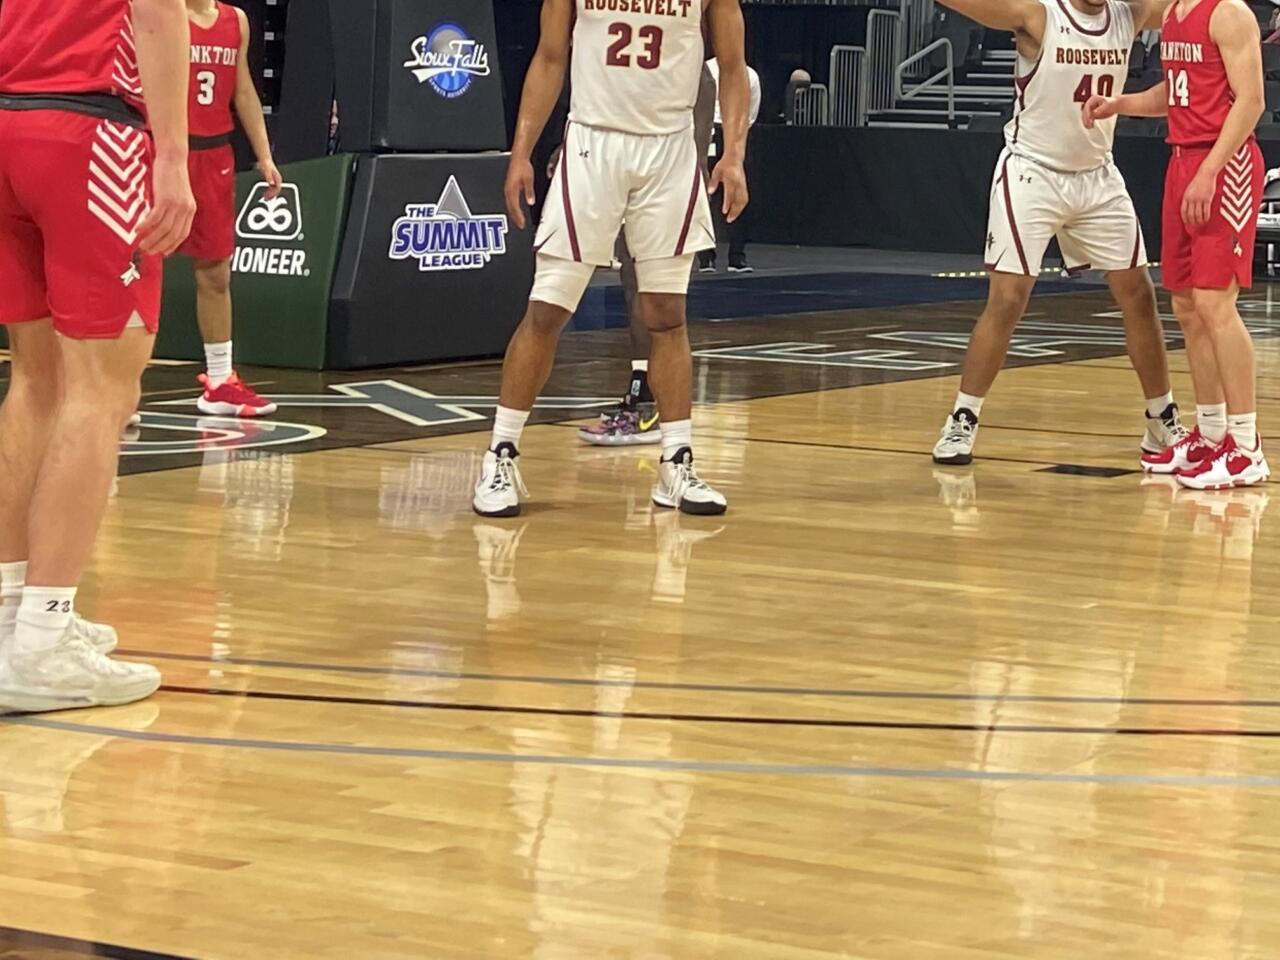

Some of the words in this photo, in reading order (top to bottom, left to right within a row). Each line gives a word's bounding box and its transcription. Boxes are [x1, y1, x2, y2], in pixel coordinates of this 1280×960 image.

[190, 45, 238, 66] NKTON
[404, 35, 453, 68] Sioux
[448, 39, 491, 77] Falls
[605, 21, 664, 70] 23
[1056, 47, 1128, 66] ROOSEVELT
[196, 70, 216, 106] 3
[1073, 74, 1114, 104] 40
[1168, 68, 1189, 107] 14
[408, 206, 435, 218] THE
[395, 221, 503, 253] SUMMIT
[230, 246, 306, 276] IONEER
[421, 253, 482, 267] LEAGUE
